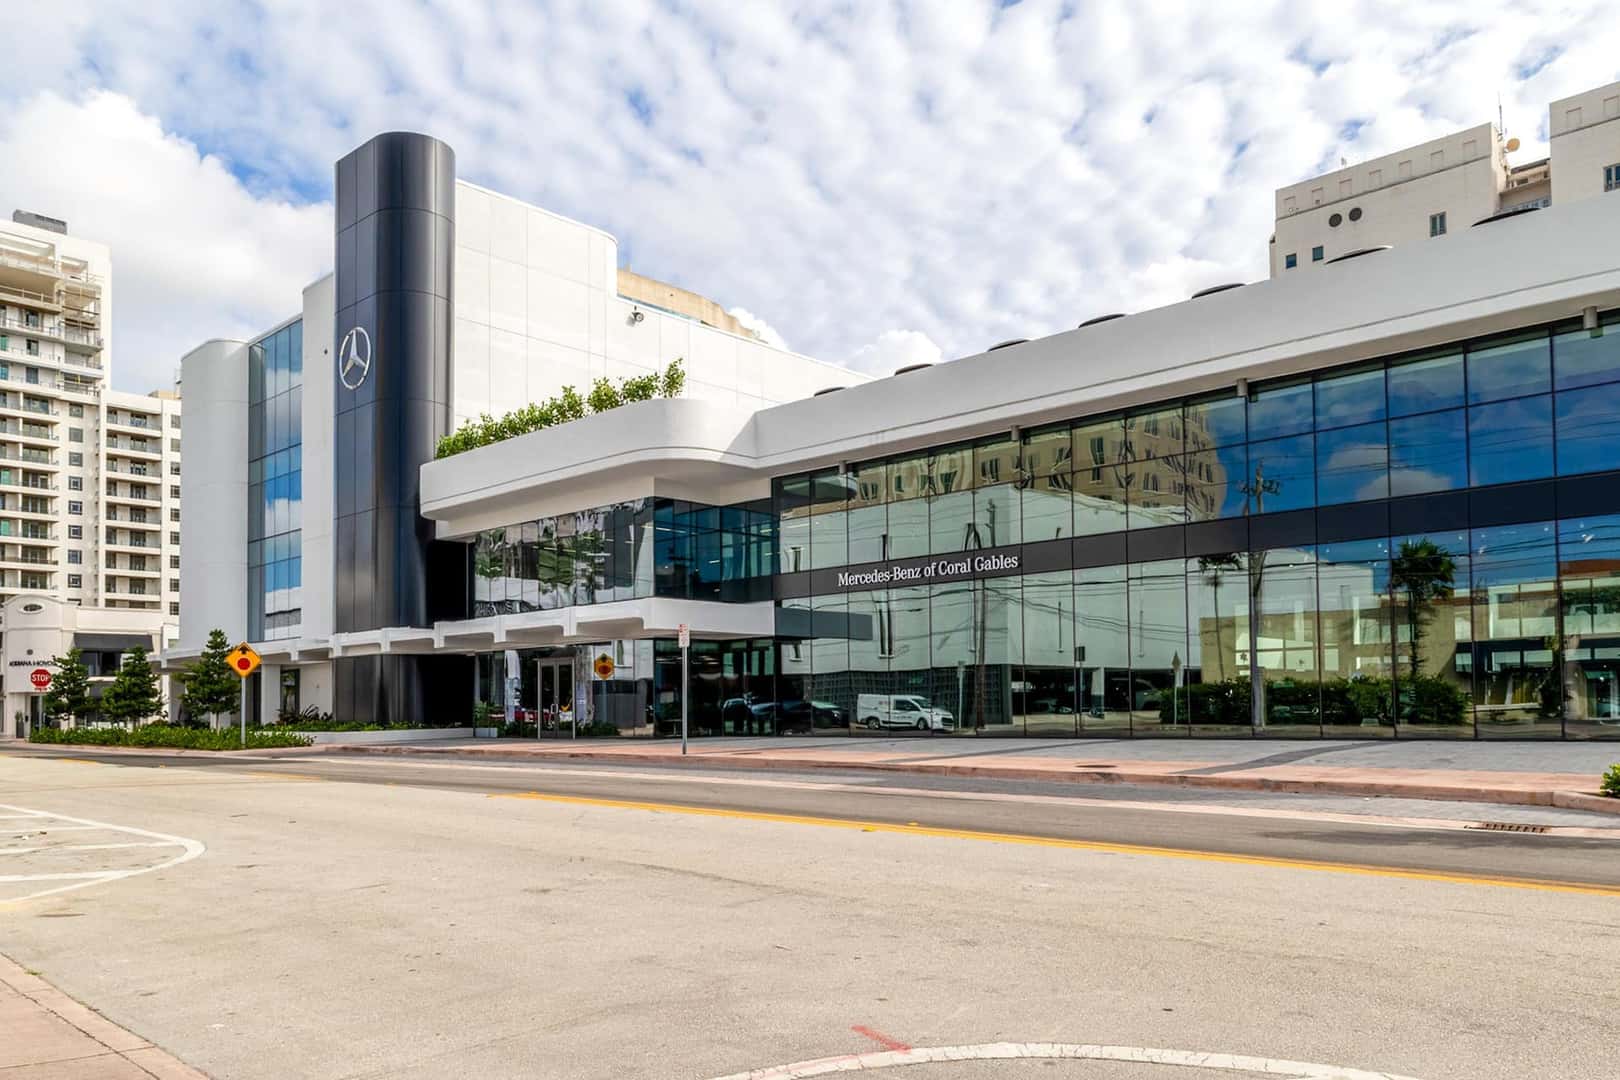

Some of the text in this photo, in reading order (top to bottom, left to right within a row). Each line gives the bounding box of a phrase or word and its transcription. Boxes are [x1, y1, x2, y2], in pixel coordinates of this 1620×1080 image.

[837, 555, 1018, 587] Mercedes-Benz of Coral Gables
[31, 673, 50, 682] STOP
